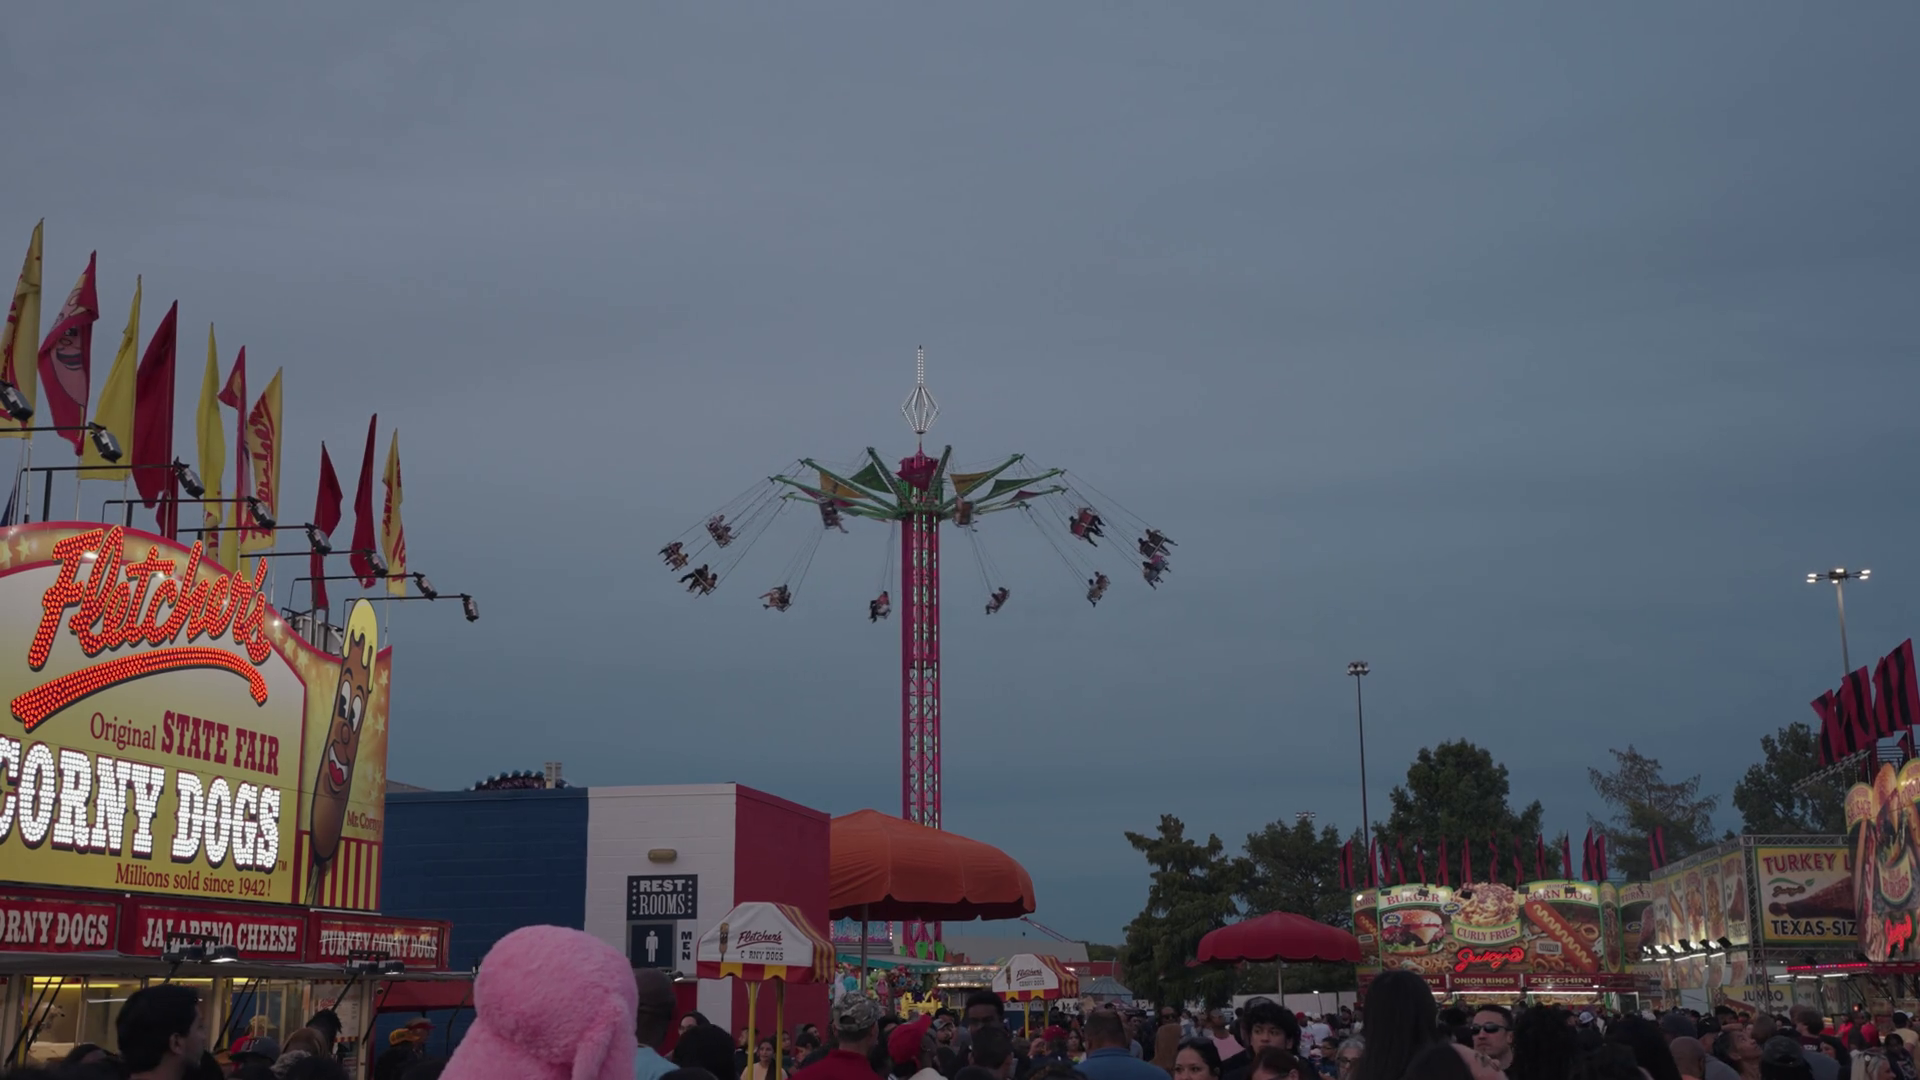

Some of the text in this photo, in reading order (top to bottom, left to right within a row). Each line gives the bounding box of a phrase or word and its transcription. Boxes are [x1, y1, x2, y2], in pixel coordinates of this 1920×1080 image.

[28, 525, 271, 671] Fletcher's
[90, 710, 279, 776] Original STATE FAIR
[171, 769, 281, 875] DOGS
[359, 812, 382, 833] Corny
[1763, 853, 1837, 875] TURKEY
[115, 862, 272, 897] Millions sold since 1942!
[639, 879, 686, 893] REST
[638, 893, 686, 915] ROOMS
[1387, 892, 1440, 905] BURGER
[1525, 889, 1592, 902] CORN DOG
[55, 911, 109, 947] DOGS
[236, 922, 298, 953] CHEESE
[737, 930, 784, 945] Fletcher's
[1457, 926, 1518, 942] CURLY FRIES
[320, 929, 438, 959] TURKEY CORNY DOGS
[681, 931, 692, 960] MEN
[740, 950, 784, 961] CRNY DOGS
[1743, 990, 1784, 1001] JUMBO
